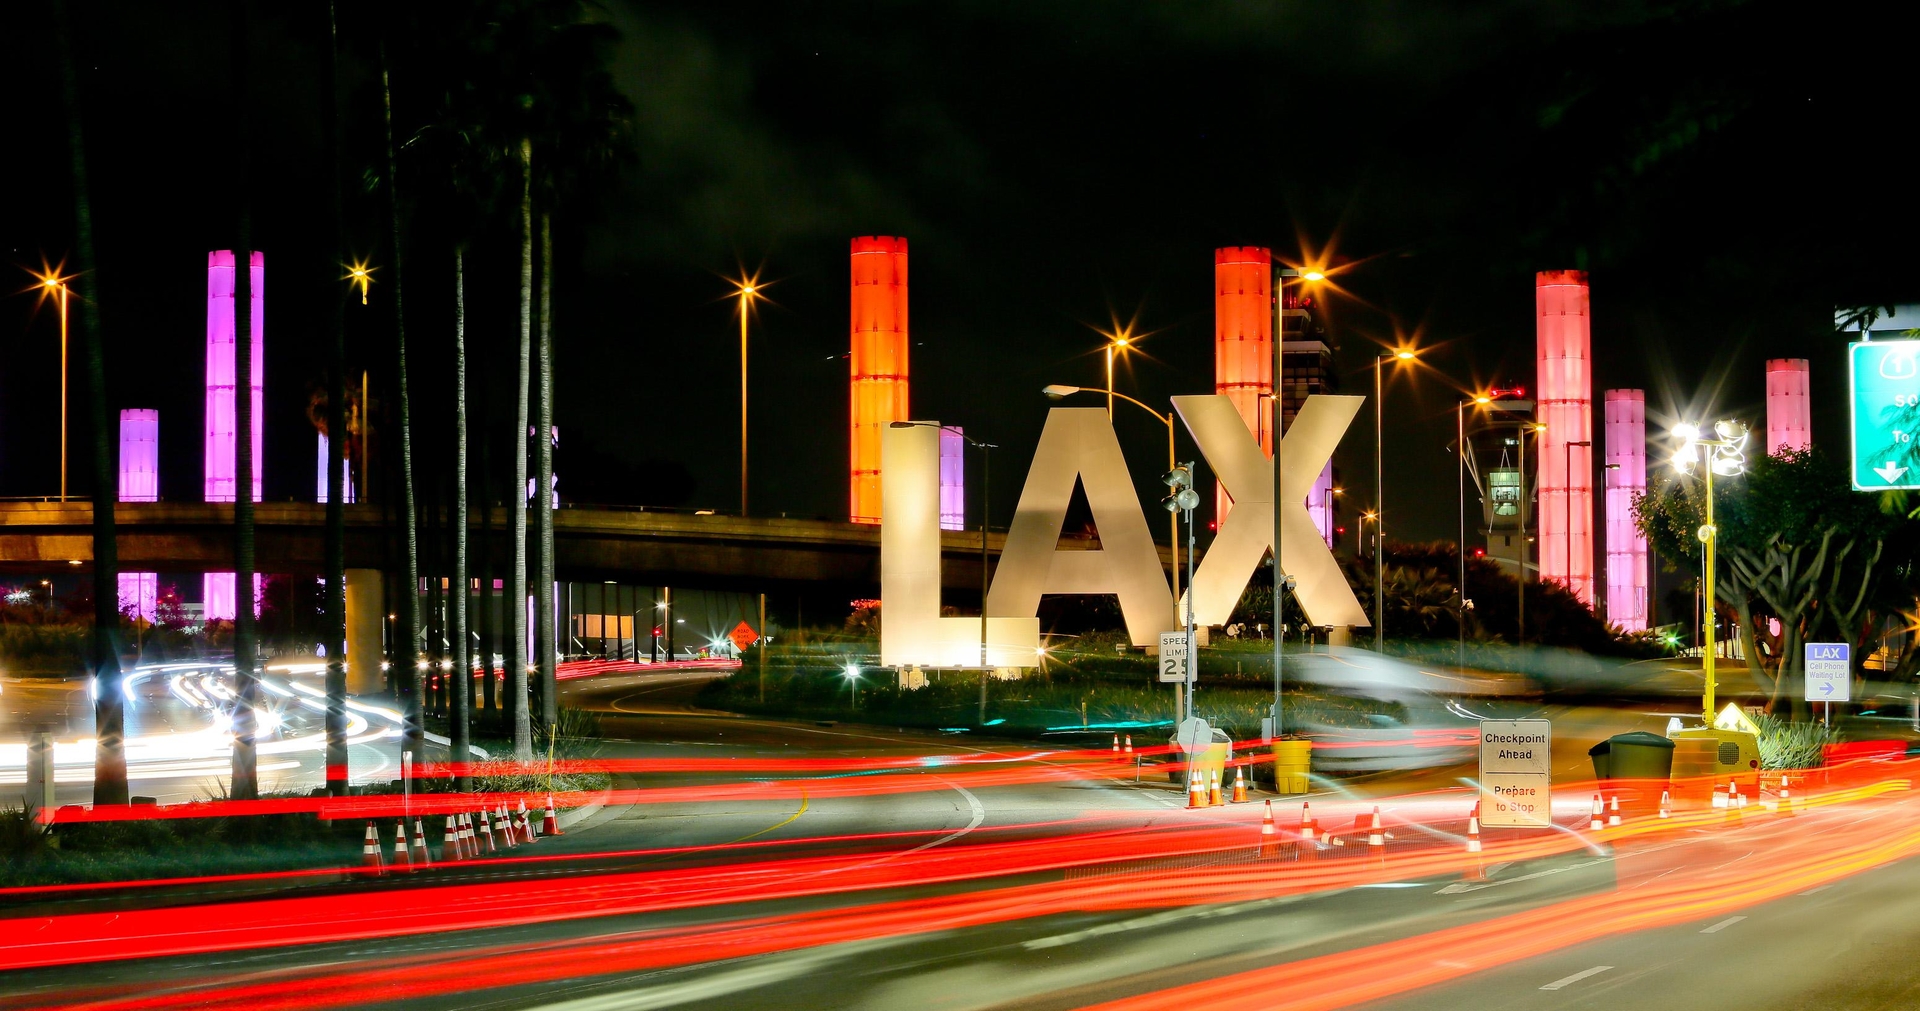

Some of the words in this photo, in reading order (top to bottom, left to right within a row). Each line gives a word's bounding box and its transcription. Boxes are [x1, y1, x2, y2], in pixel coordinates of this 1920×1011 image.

[1891, 430, 1910, 443] To
[881, 394, 1370, 668] LAX
[1814, 648, 1840, 659] LAX
[1809, 672, 1833, 680] Waiting
[1485, 733, 1546, 746] Checkpoint
[1498, 749, 1532, 760] Ahead
[1494, 785, 1536, 798] Prepare
[1496, 802, 1506, 812] to
[1510, 802, 1535, 814] Stop
